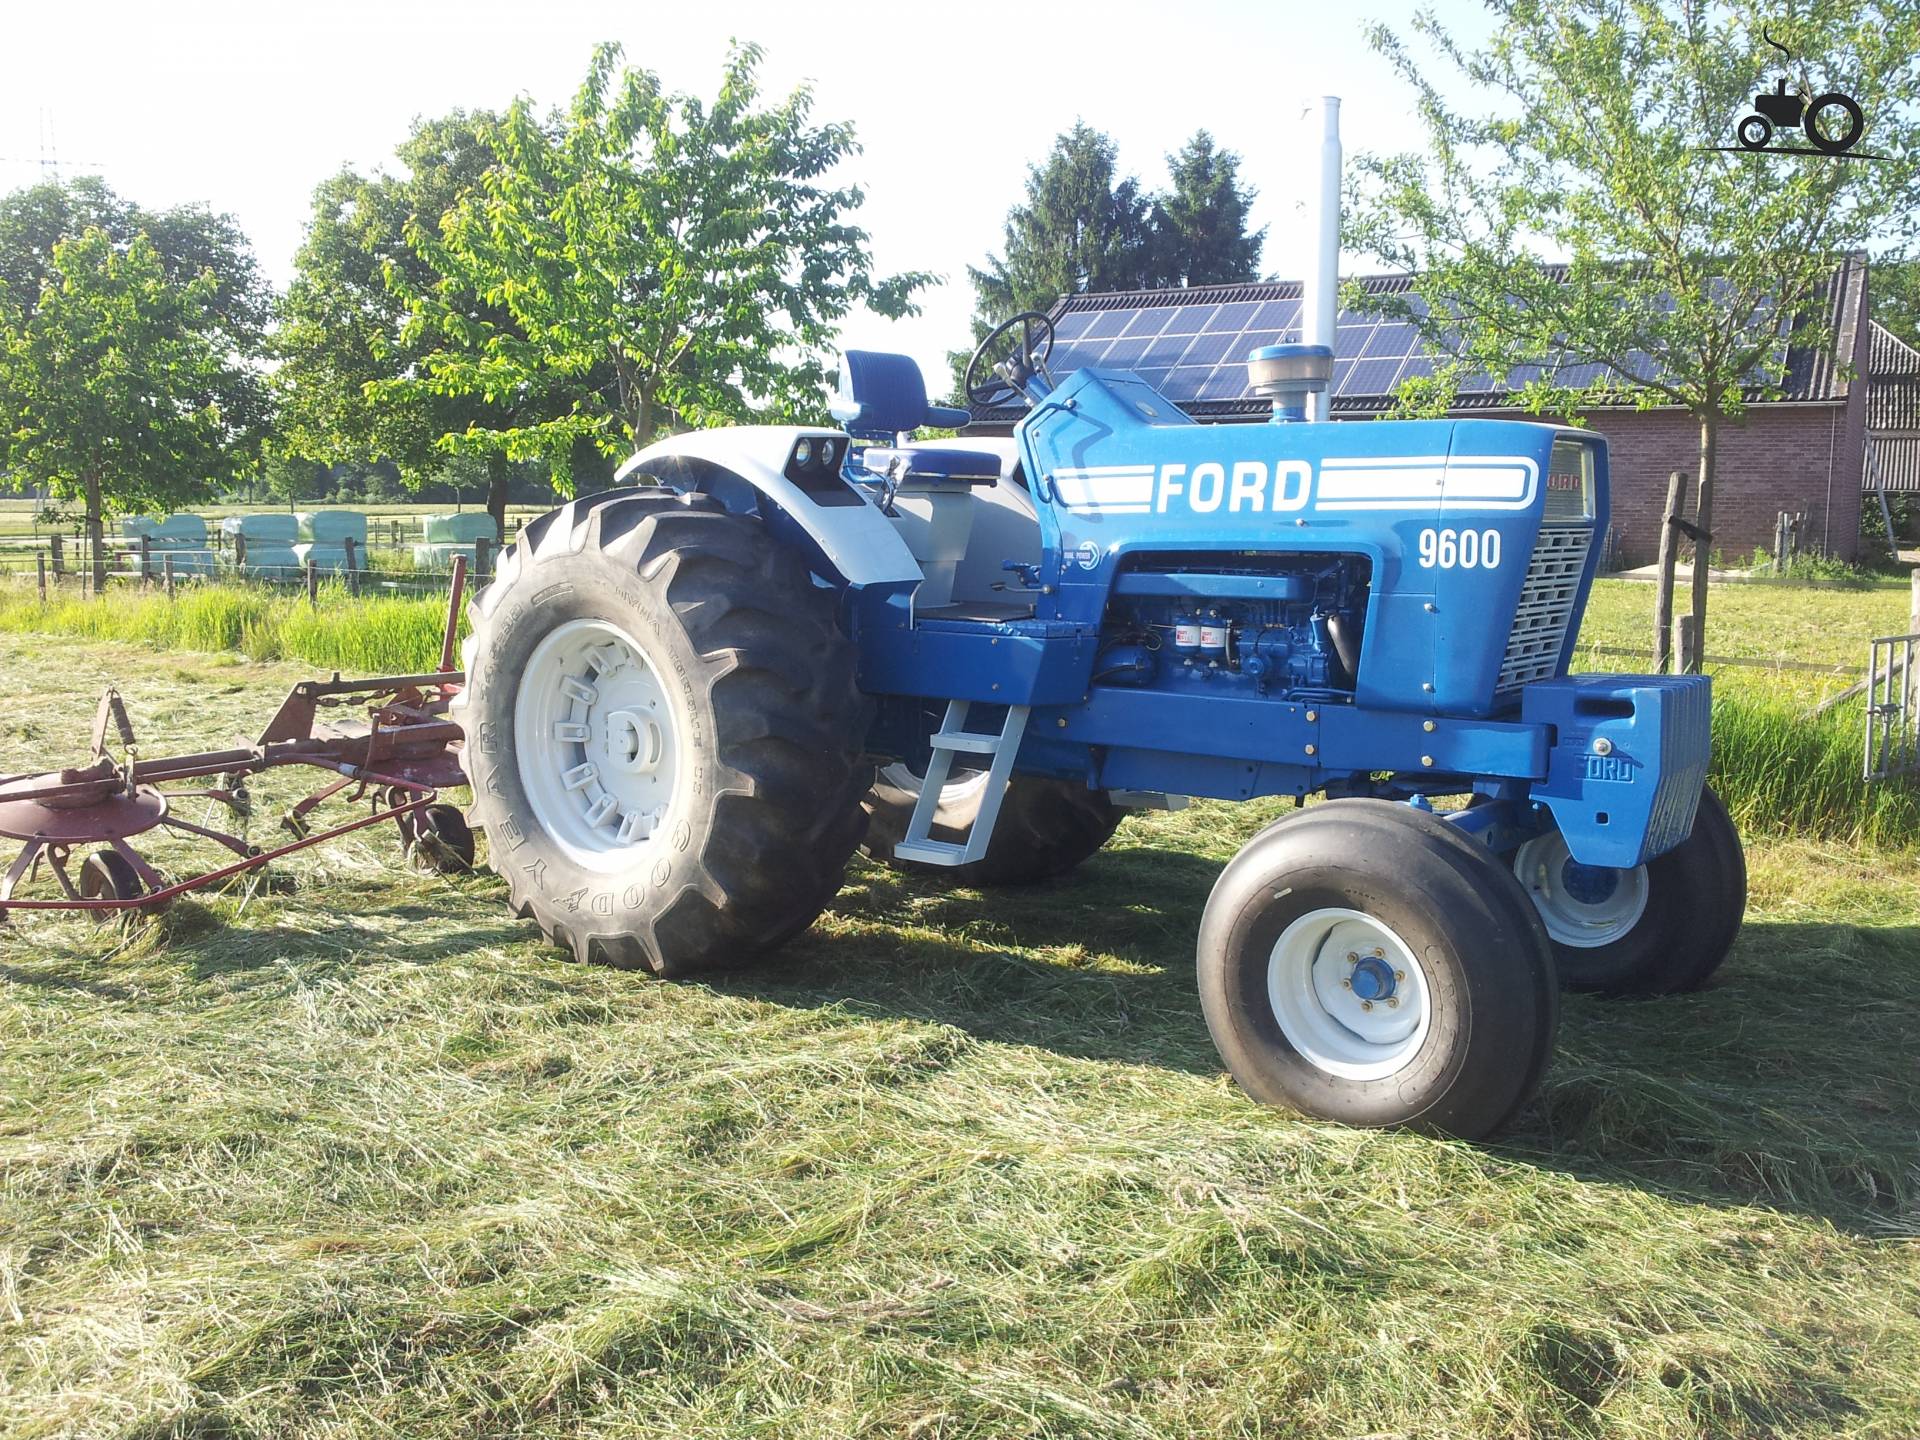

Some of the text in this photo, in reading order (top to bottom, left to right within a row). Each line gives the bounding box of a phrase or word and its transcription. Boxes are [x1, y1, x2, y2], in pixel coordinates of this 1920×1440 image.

[1157, 460, 1313, 513] FORD
[1547, 474, 1581, 491] ORD
[1418, 528, 1501, 570] 9600
[480, 720, 691, 917] GOODYEAR
